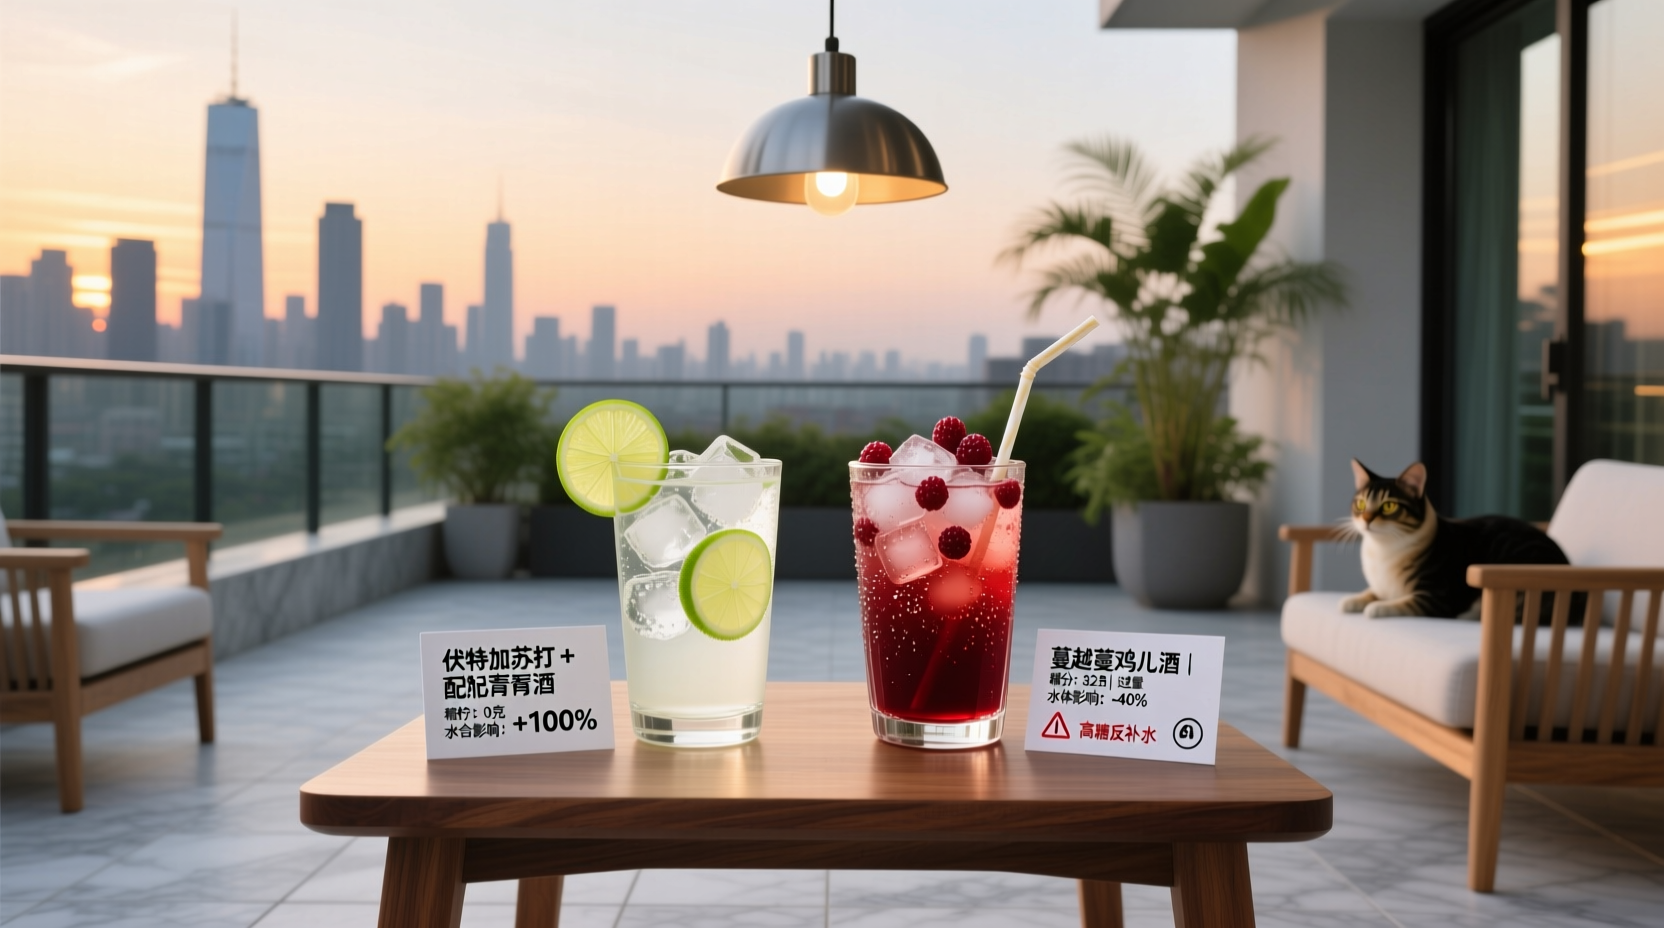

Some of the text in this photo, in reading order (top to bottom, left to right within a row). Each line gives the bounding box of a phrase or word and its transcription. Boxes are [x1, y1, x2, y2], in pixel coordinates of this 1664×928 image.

[442, 645, 555, 672] 伏特加苏打
[1111, 692, 1148, 707] -40%
[513, 708, 598, 733] +100%
